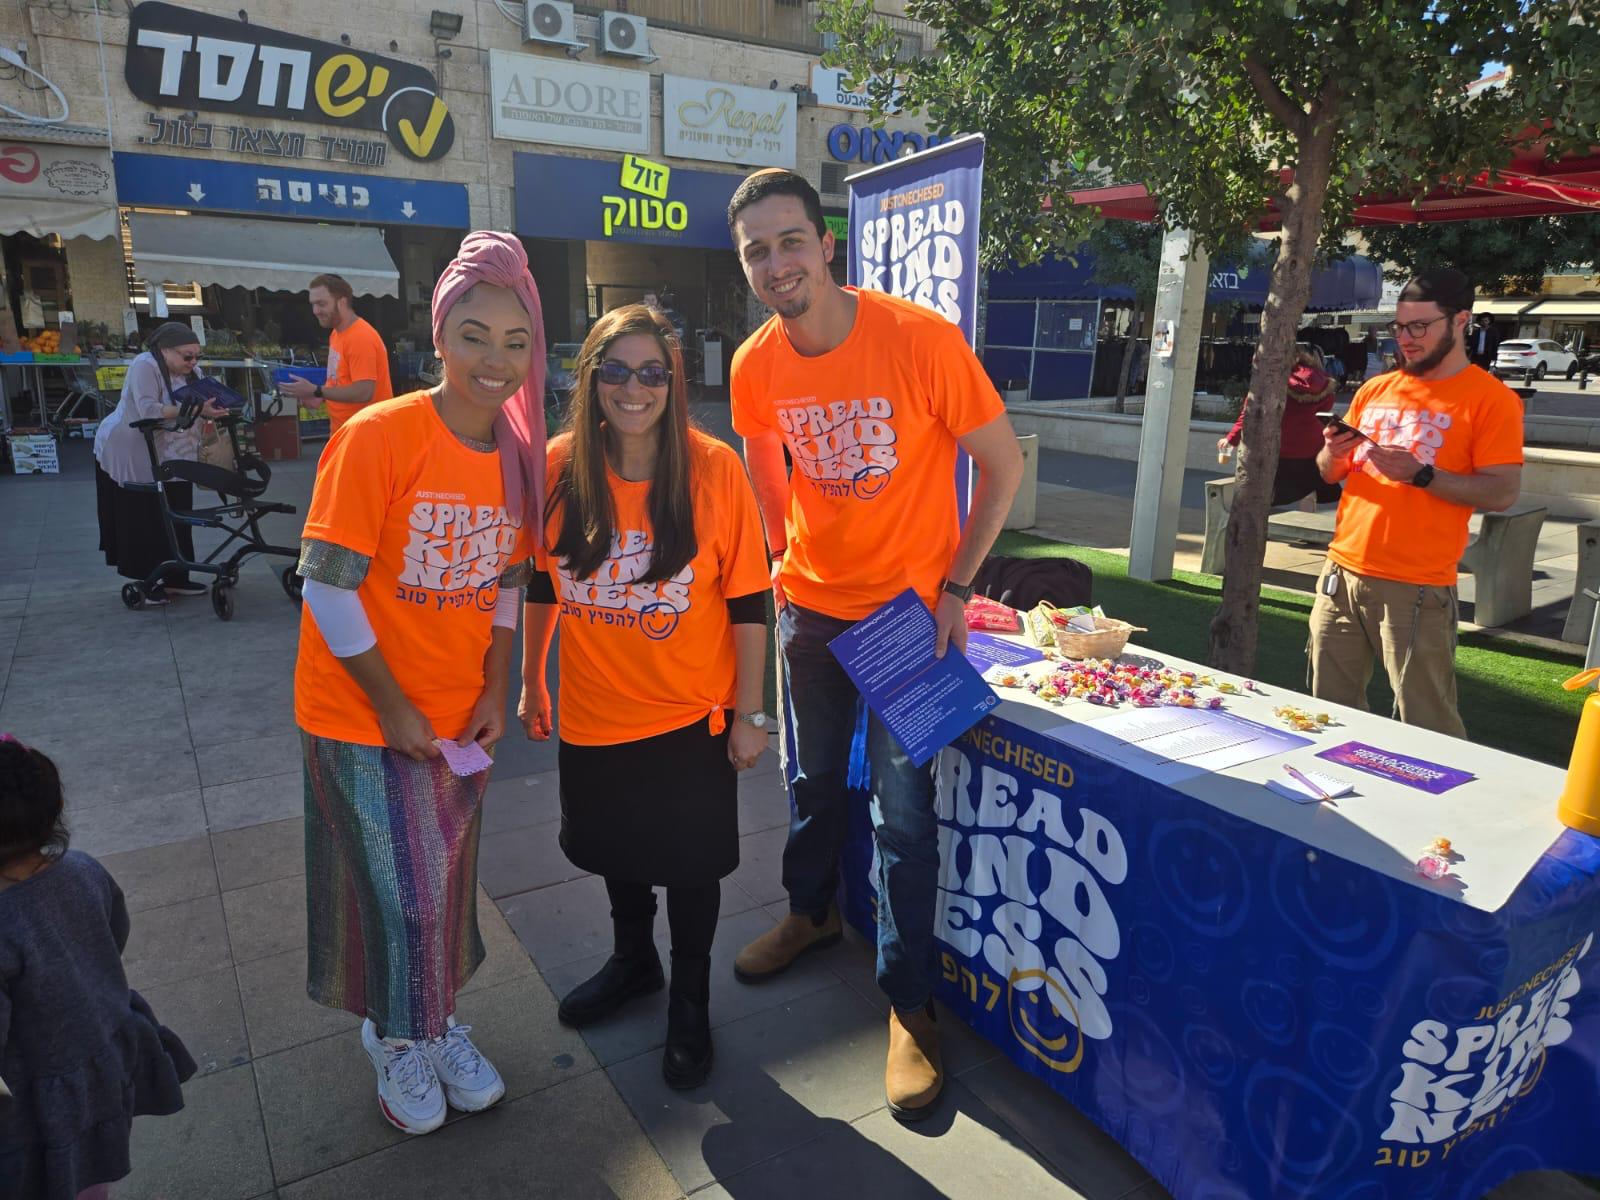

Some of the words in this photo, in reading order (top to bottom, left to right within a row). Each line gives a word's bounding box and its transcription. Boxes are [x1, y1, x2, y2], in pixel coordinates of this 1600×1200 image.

[137, 28, 312, 110] חסד
[502, 73, 642, 119] ADORE
[678, 88, 786, 136] Regal
[229, 125, 306, 159] תצאו
[318, 135, 388, 167] תמיד
[257, 178, 370, 208] כניסה
[631, 157, 663, 191] זול
[602, 196, 688, 236] סטוק
[862, 200, 965, 263] SPREAD
[1209, 272, 1239, 289] בזא
[777, 397, 893, 436] SPREAD
[785, 418, 897, 461] KIND
[796, 445, 899, 480] NESS
[403, 529, 515, 569] KIND
[396, 586, 427, 605] טוב
[558, 573, 691, 614] NESS
[561, 602, 581, 618] טוב
[588, 609, 635, 628] להפיץ
[932, 745, 1128, 885] READ
[937, 825, 1121, 960] IND
[933, 888, 1113, 1040] ESS
[941, 952, 1001, 1012] להפ
[1374, 1147, 1431, 1168] טוב
